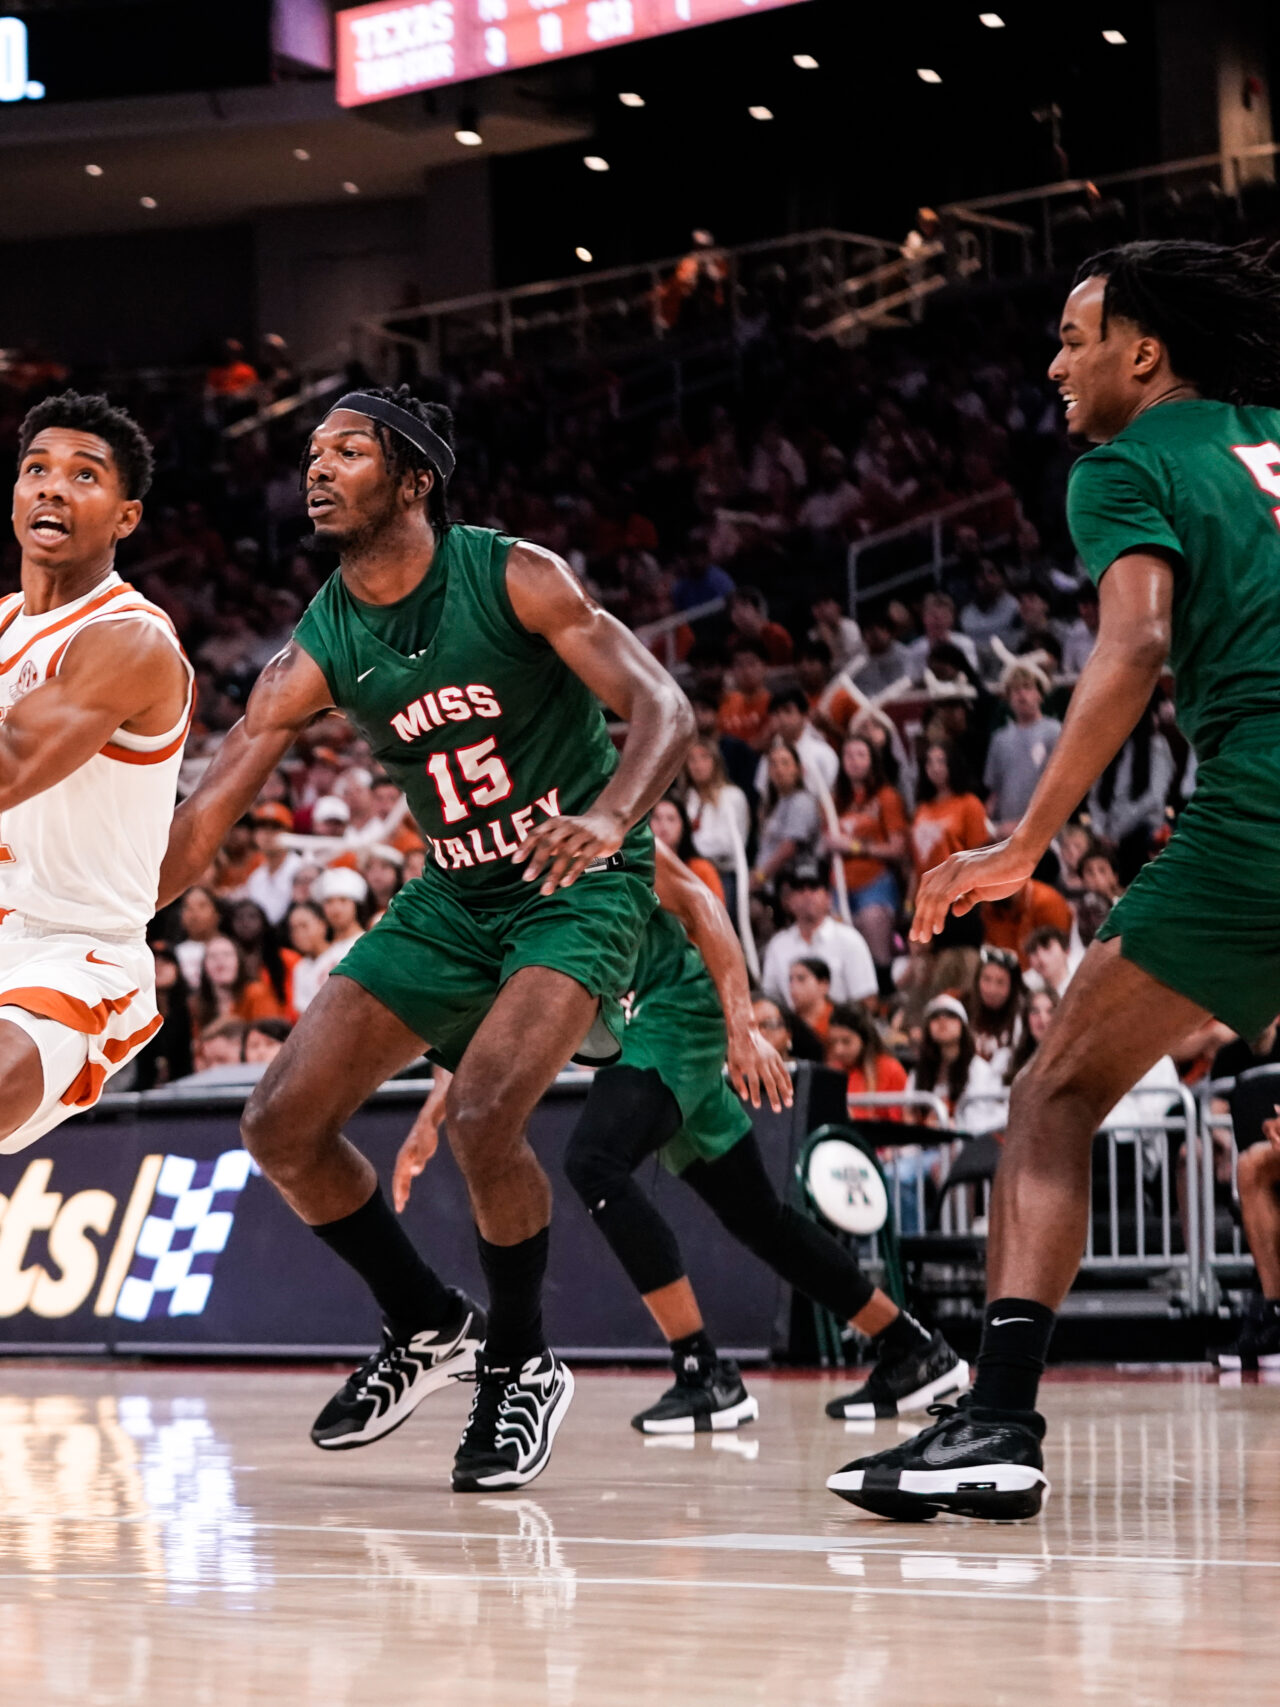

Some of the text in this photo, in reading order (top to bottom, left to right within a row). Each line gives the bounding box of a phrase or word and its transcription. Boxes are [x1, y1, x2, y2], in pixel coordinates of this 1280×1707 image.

[351, 1, 454, 59] TEXAS
[389, 684, 503, 743] MISS
[426, 734, 514, 825] 15
